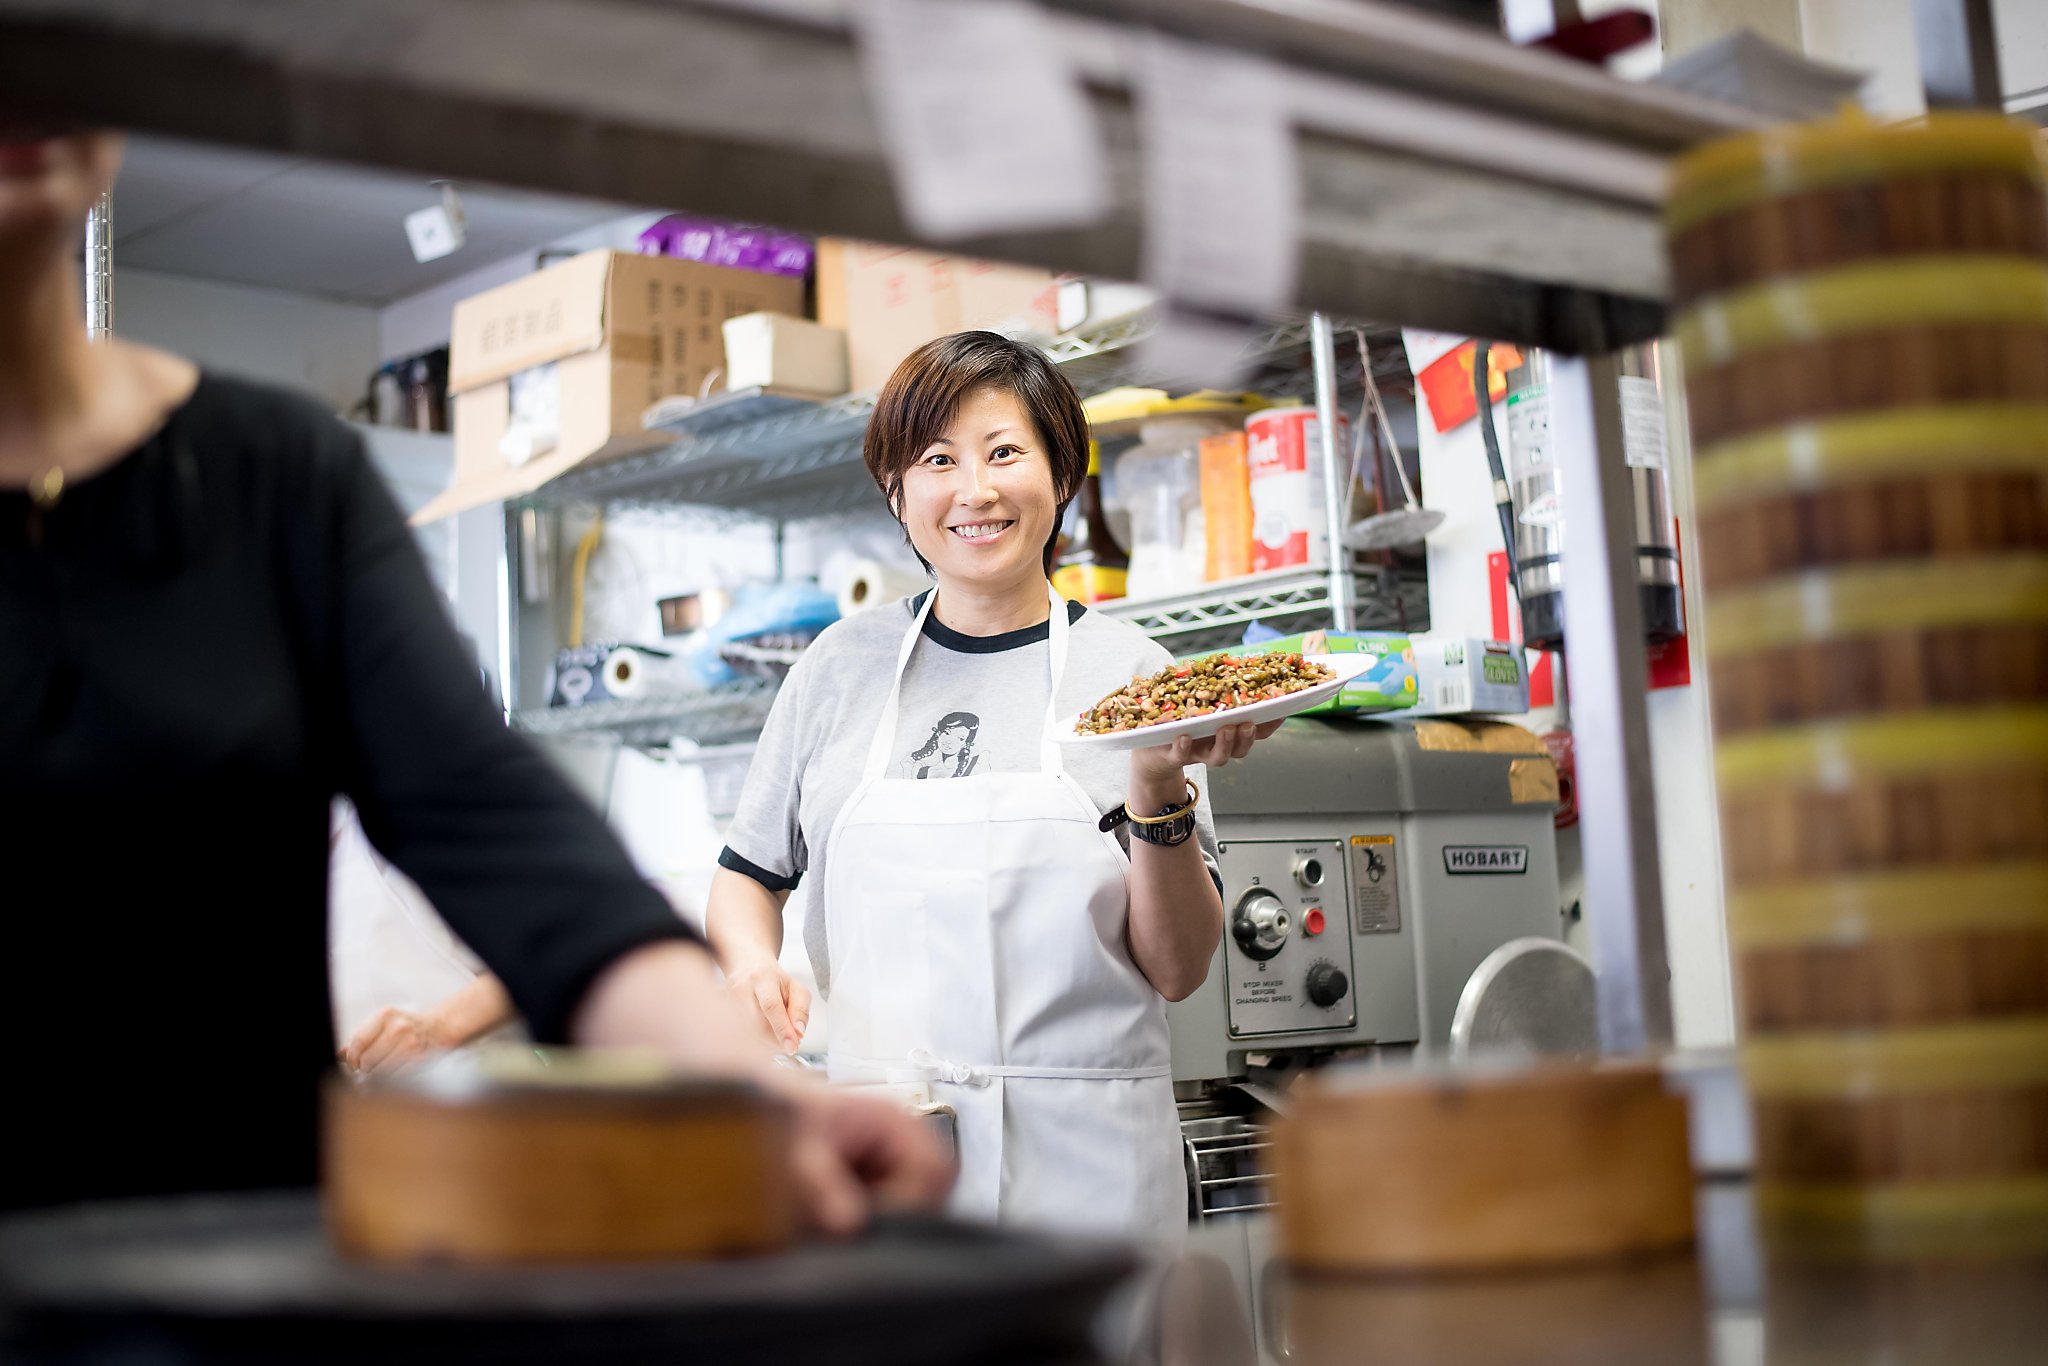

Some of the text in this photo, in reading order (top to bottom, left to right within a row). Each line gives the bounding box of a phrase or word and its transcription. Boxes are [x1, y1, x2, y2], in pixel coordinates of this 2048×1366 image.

[1452, 851, 1521, 866] HOBART
[1252, 876, 1260, 885] 3
[1258, 962, 1266, 972] 2
[1235, 996, 1270, 1005] CHANGING
